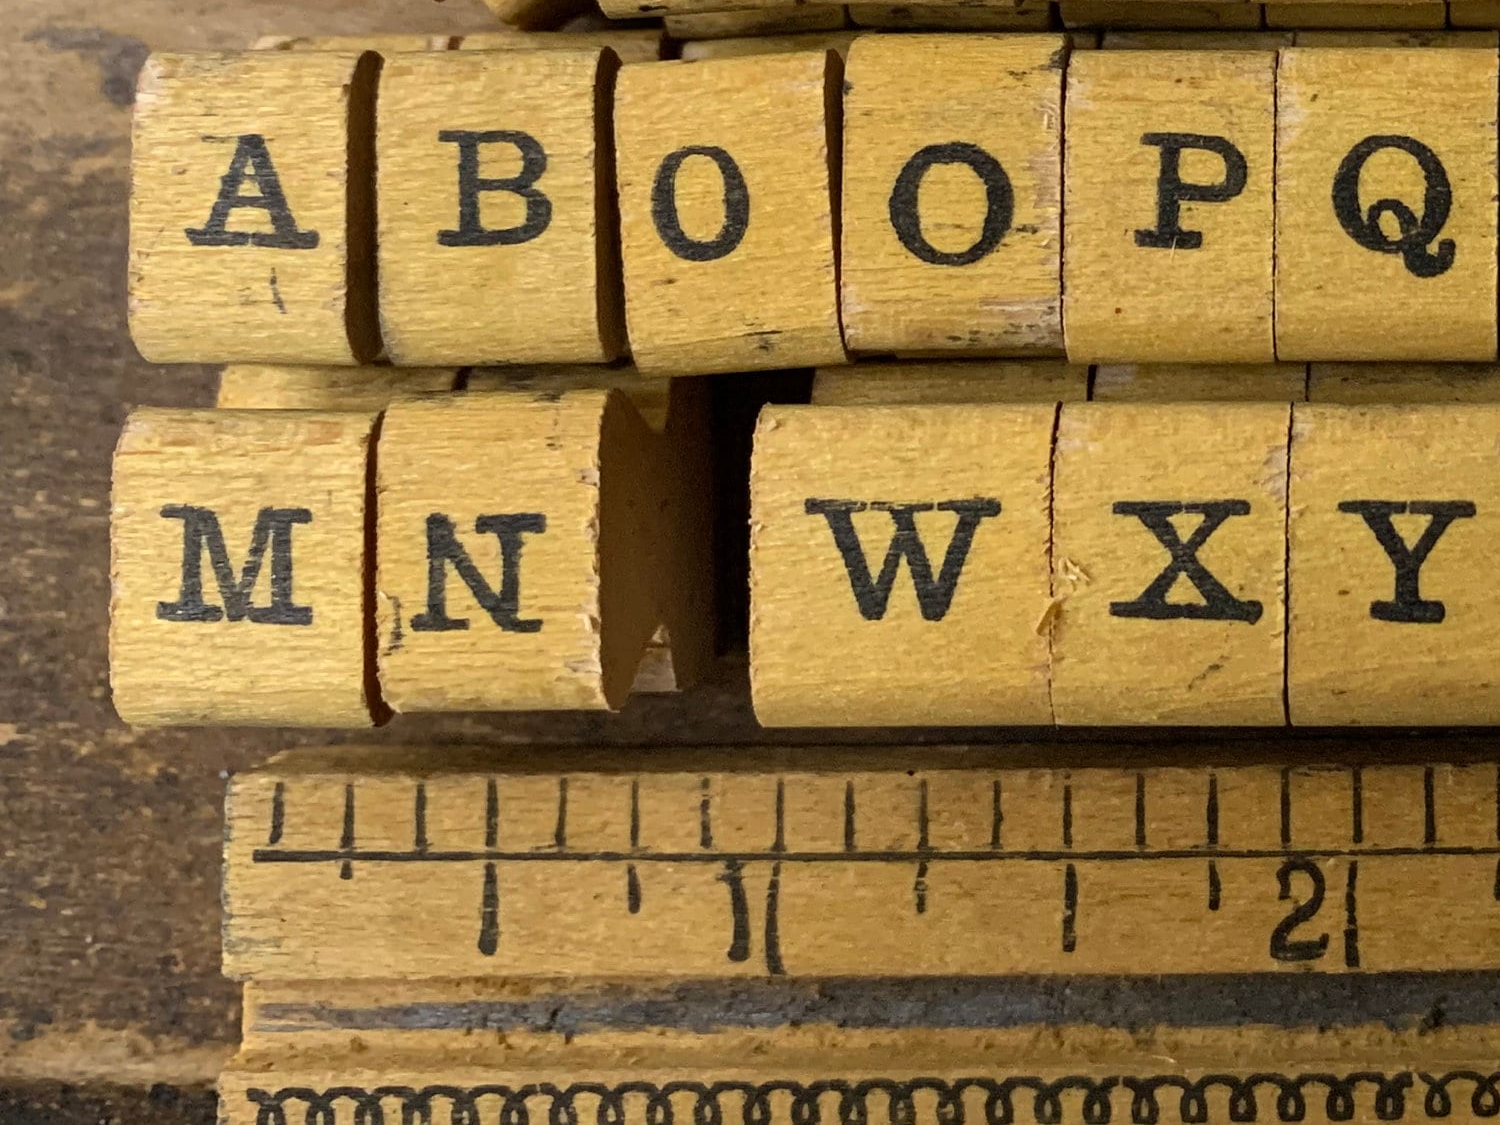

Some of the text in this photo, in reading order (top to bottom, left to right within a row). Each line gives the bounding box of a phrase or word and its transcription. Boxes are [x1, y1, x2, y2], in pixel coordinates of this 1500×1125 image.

[184, 131, 321, 250] A
[436, 129, 554, 247] B
[1134, 131, 1248, 249] P
[1332, 132, 1456, 278] Q
[156, 503, 313, 627] M
[410, 511, 550, 633] N
[803, 496, 1001, 621] W
[1107, 499, 1264, 624] X
[1338, 497, 1476, 623] Y
[718, 861, 750, 963] 1
[1270, 858, 1329, 962] 2
